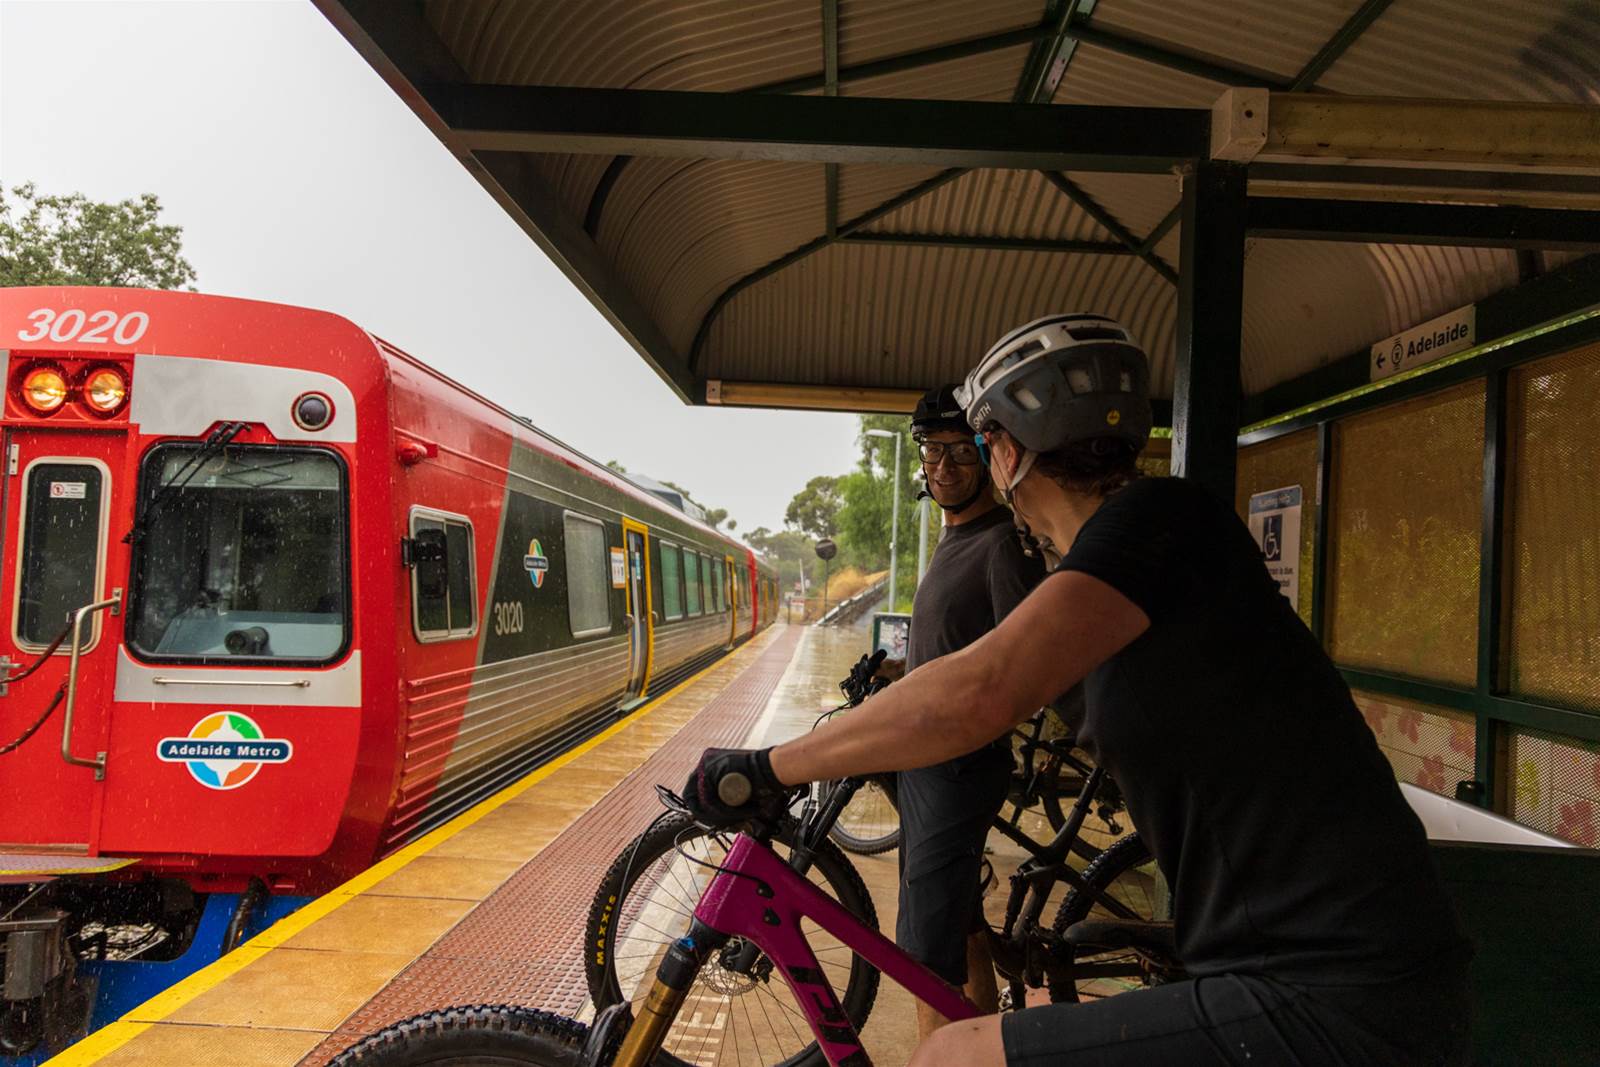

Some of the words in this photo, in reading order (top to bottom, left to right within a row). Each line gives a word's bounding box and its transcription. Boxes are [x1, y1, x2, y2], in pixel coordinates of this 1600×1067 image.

[17, 308, 150, 345] 3020
[1407, 323, 1469, 358] Adelaide
[973, 401, 992, 429] SMITH
[494, 601, 524, 636] 3020
[168, 744, 231, 756] Adelaide
[237, 746, 281, 757] Metro
[596, 895, 617, 966] MAXXIS
